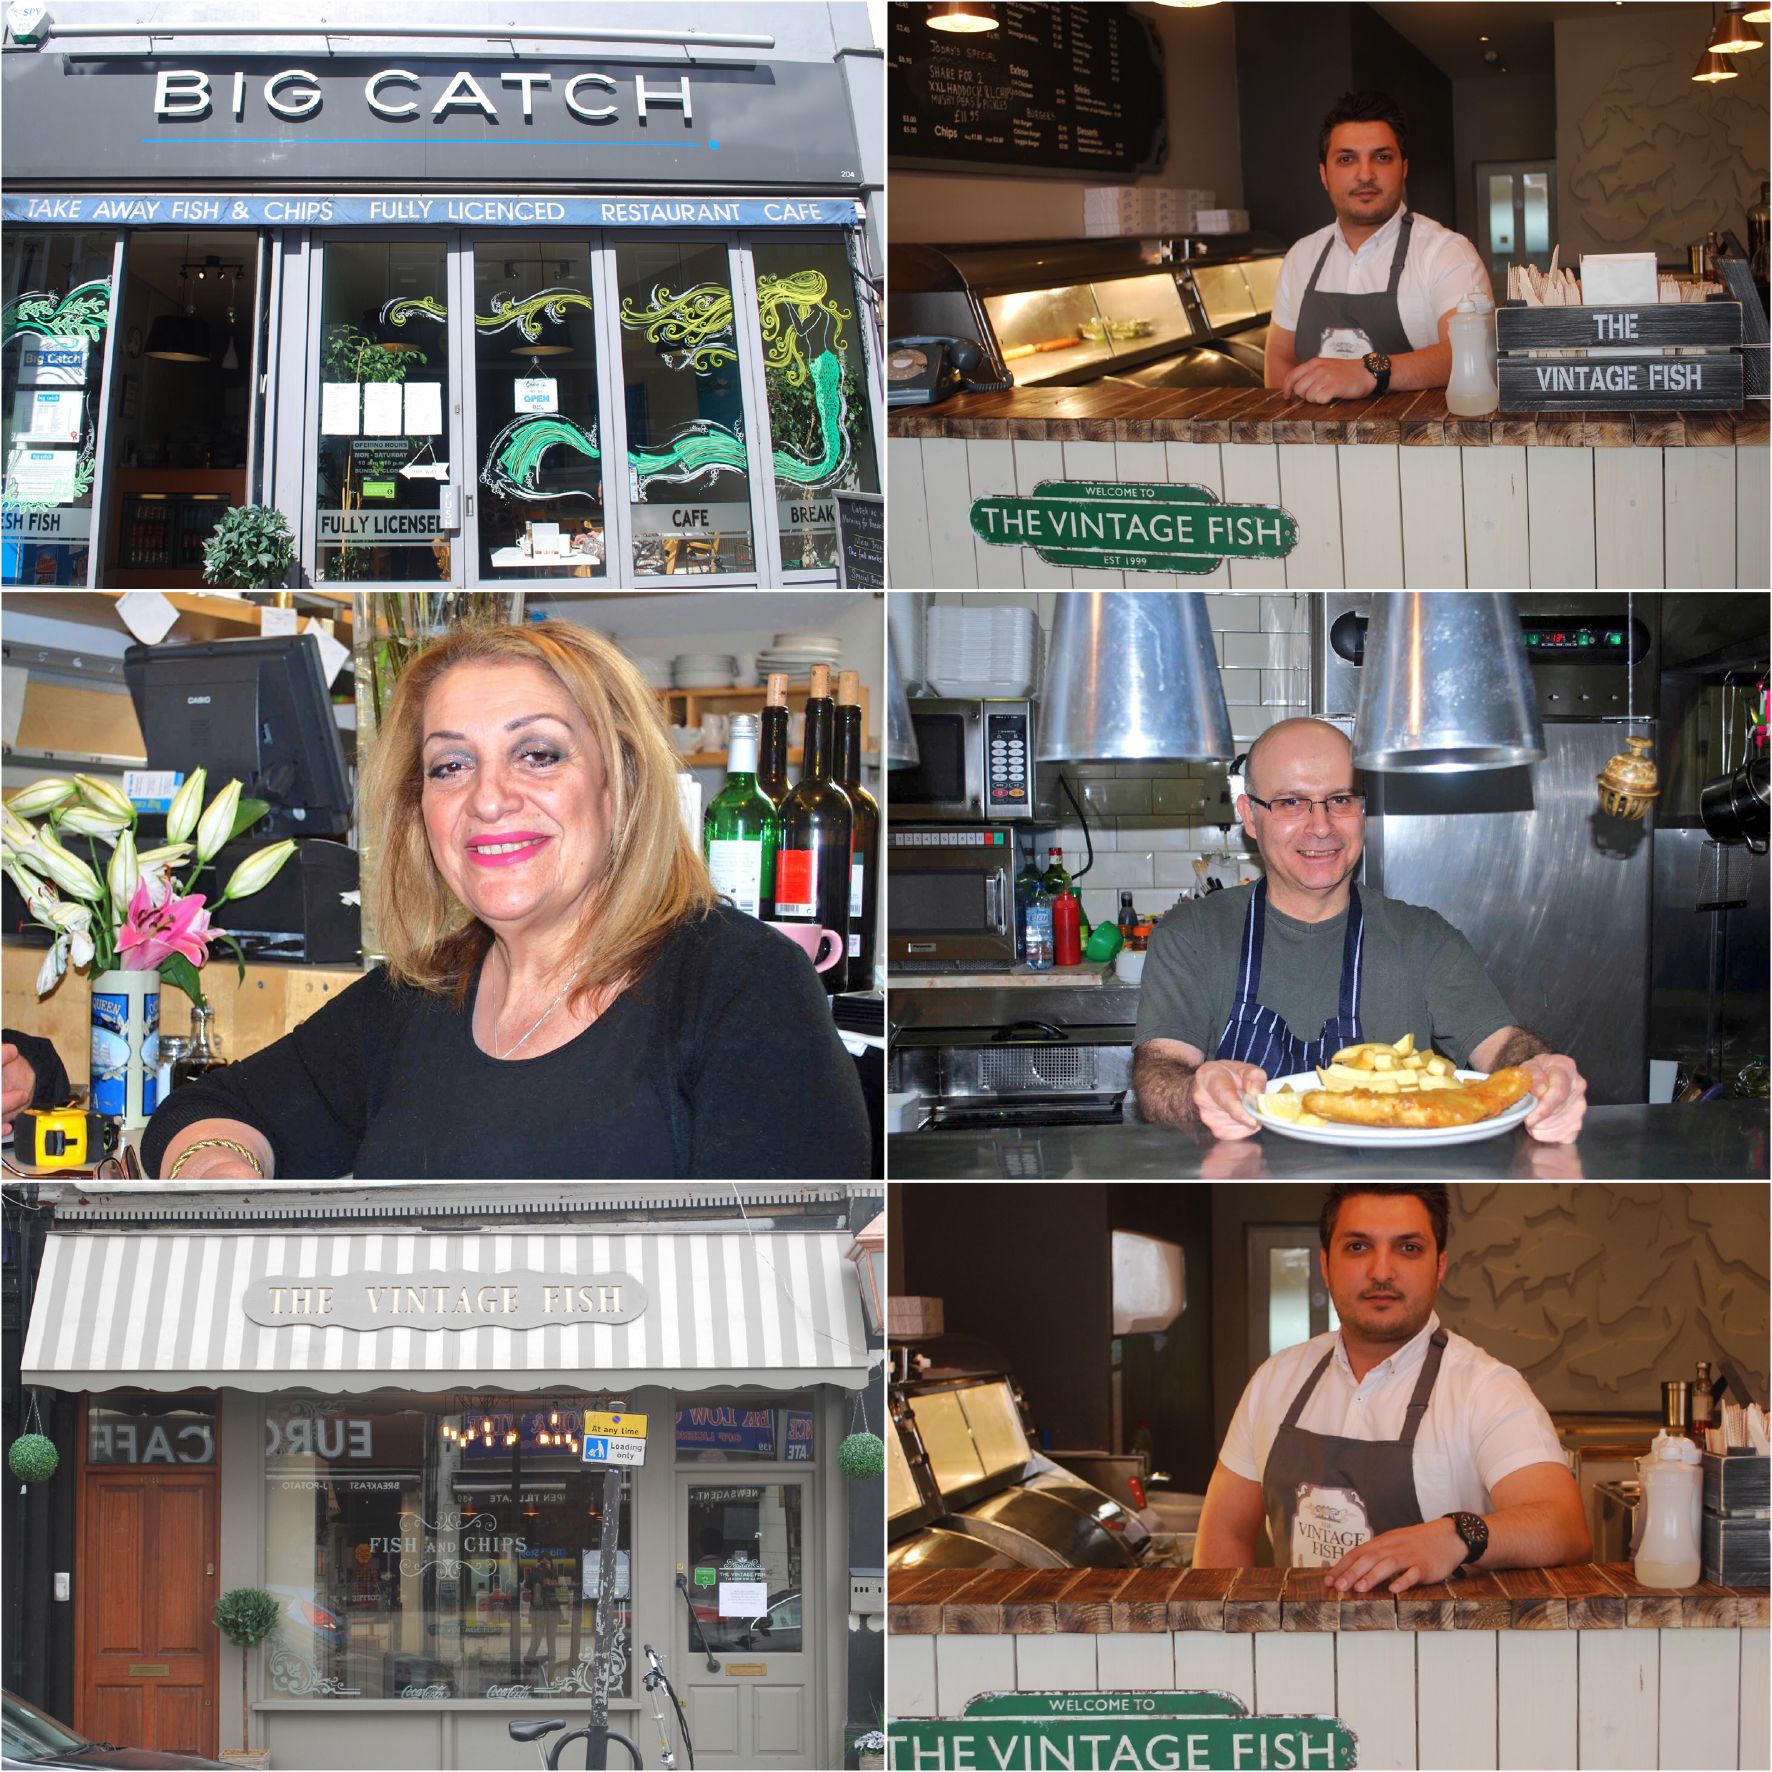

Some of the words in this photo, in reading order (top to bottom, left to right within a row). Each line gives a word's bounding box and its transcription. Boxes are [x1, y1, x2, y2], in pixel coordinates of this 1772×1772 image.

[929, 64, 956, 80] SHARE
[958, 69, 973, 83] FOR
[1009, 64, 1030, 78] Extras
[154, 69, 322, 115] BIG
[365, 69, 693, 119] CATCH
[946, 82, 982, 97] HADDOCK
[934, 124, 958, 140] Chips
[841, 170, 855, 178] 204
[27, 199, 81, 219] TAKE
[93, 200, 159, 220] AWAY
[172, 201, 219, 220] FISH
[231, 201, 249, 220] &
[264, 201, 334, 221] CHIPS
[370, 201, 433, 219] FULLY
[447, 201, 566, 221] LICENCED
[601, 203, 740, 222] RESTAURANT
[763, 203, 823, 221] CAFE
[1592, 313, 1639, 339] THE
[26, 353, 44, 366] Big
[47, 353, 82, 364] Catch
[1536, 365, 1639, 391] VINTAGE
[1649, 364, 1702, 391] FISH
[524, 394, 550, 403] OPEN
[1085, 487, 1139, 498] WELCOME
[1141, 488, 1155, 498] TO
[29, 513, 61, 531] FISH
[321, 516, 369, 534] FULLY
[672, 509, 710, 528] CAFE
[980, 507, 1043, 537] THE
[1047, 510, 1194, 544] VINTAGE
[1207, 516, 1282, 546] FISH
[1103, 555, 1121, 566] EST
[1125, 556, 1147, 567] 1999
[38, 652, 48, 662] 5
[73, 657, 83, 668] 6
[187, 696, 211, 704] CASIO
[93, 998, 121, 1014] QUEEN
[268, 1286, 334, 1315] THE
[365, 1285, 519, 1314] VINTAGE
[542, 1285, 624, 1314] FISH
[621, 1427, 639, 1435] time
[610, 1442, 643, 1453] Loading
[616, 1453, 635, 1461] only
[1298, 1521, 1366, 1547] VINTAGE
[369, 1537, 417, 1553] FISH
[426, 1542, 456, 1553] AND
[464, 1536, 528, 1553] CHIPS
[1312, 1540, 1345, 1560] FISH
[401, 1685, 449, 1700] Coca-Cola
[486, 1684, 532, 1699] Coca-Cola
[1049, 1699, 1129, 1711] WELCOME
[1134, 1698, 1156, 1711] TO
[887, 1734, 976, 1770] THE
[986, 1733, 1210, 1770] VINTAGE
[1232, 1733, 1336, 1770] FISH
